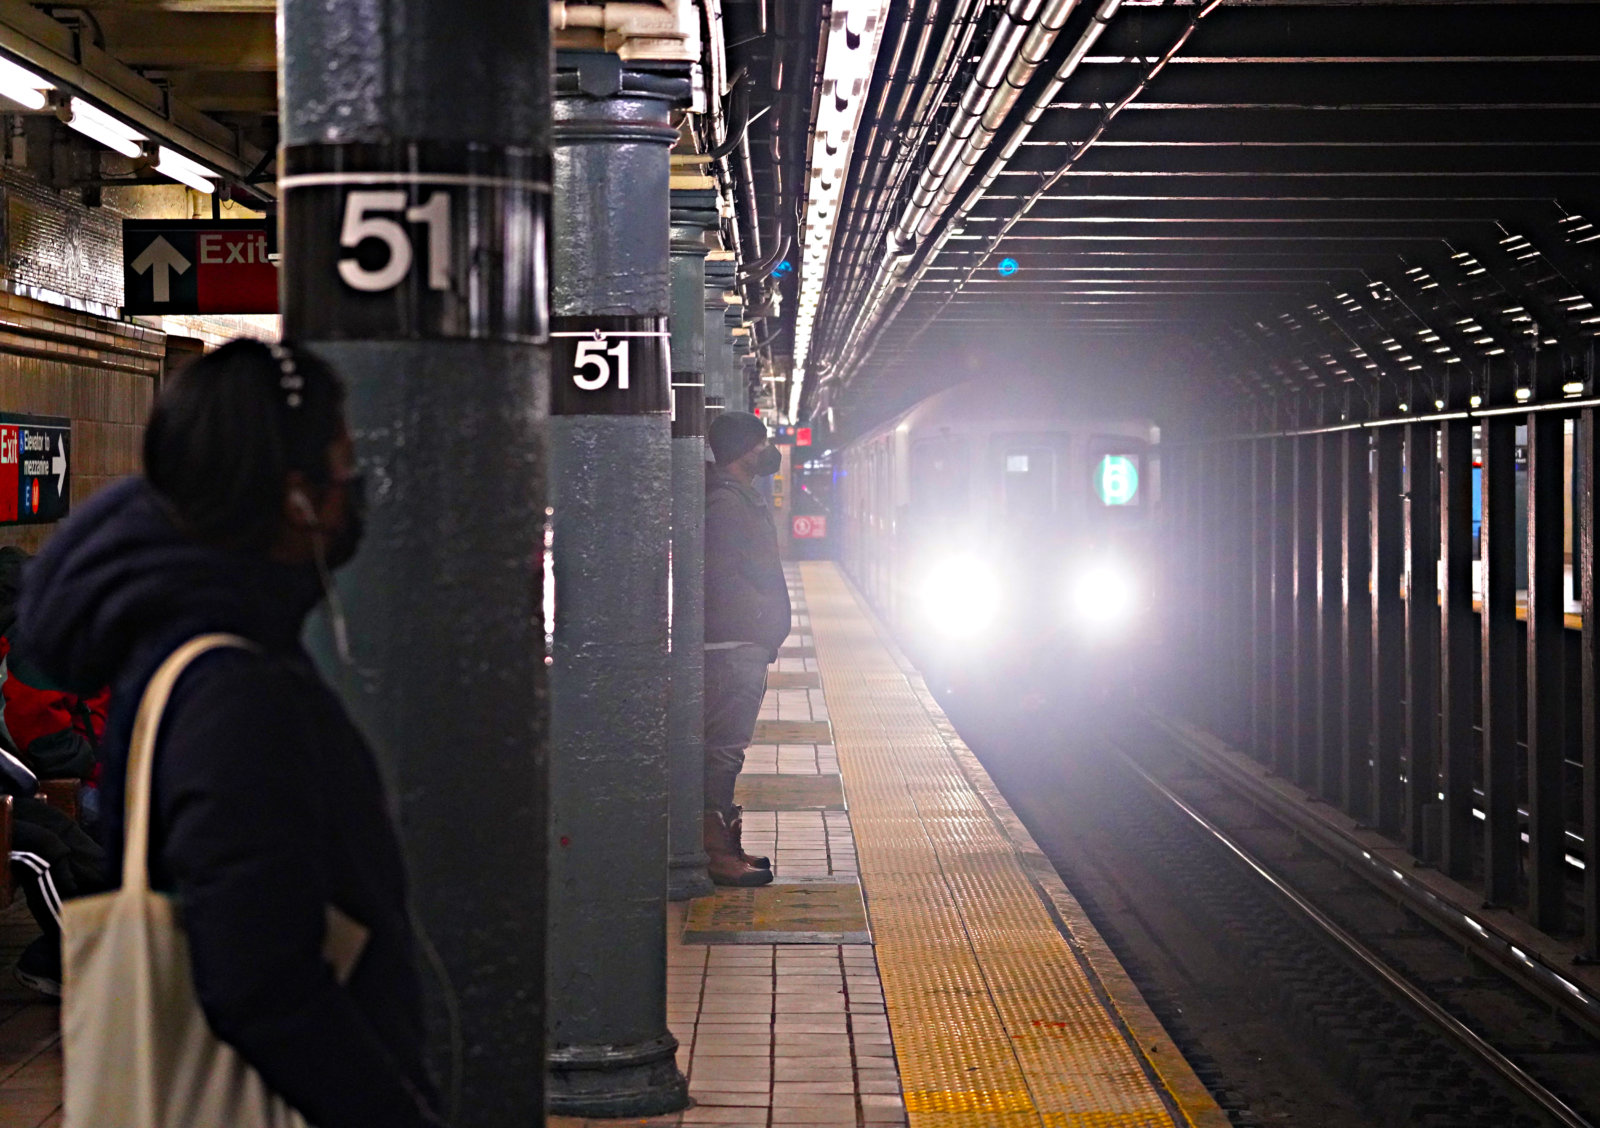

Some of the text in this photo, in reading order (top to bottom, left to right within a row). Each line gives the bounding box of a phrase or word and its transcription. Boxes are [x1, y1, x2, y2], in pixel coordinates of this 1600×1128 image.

[200, 233, 269, 264] Exit
[337, 190, 452, 291] 51
[572, 340, 629, 390] 51
[1, 429, 18, 464] Exit
[24, 430, 43, 451] Elevator
[24, 455, 50, 476] mezzanine
[1102, 464, 1129, 498] 6
